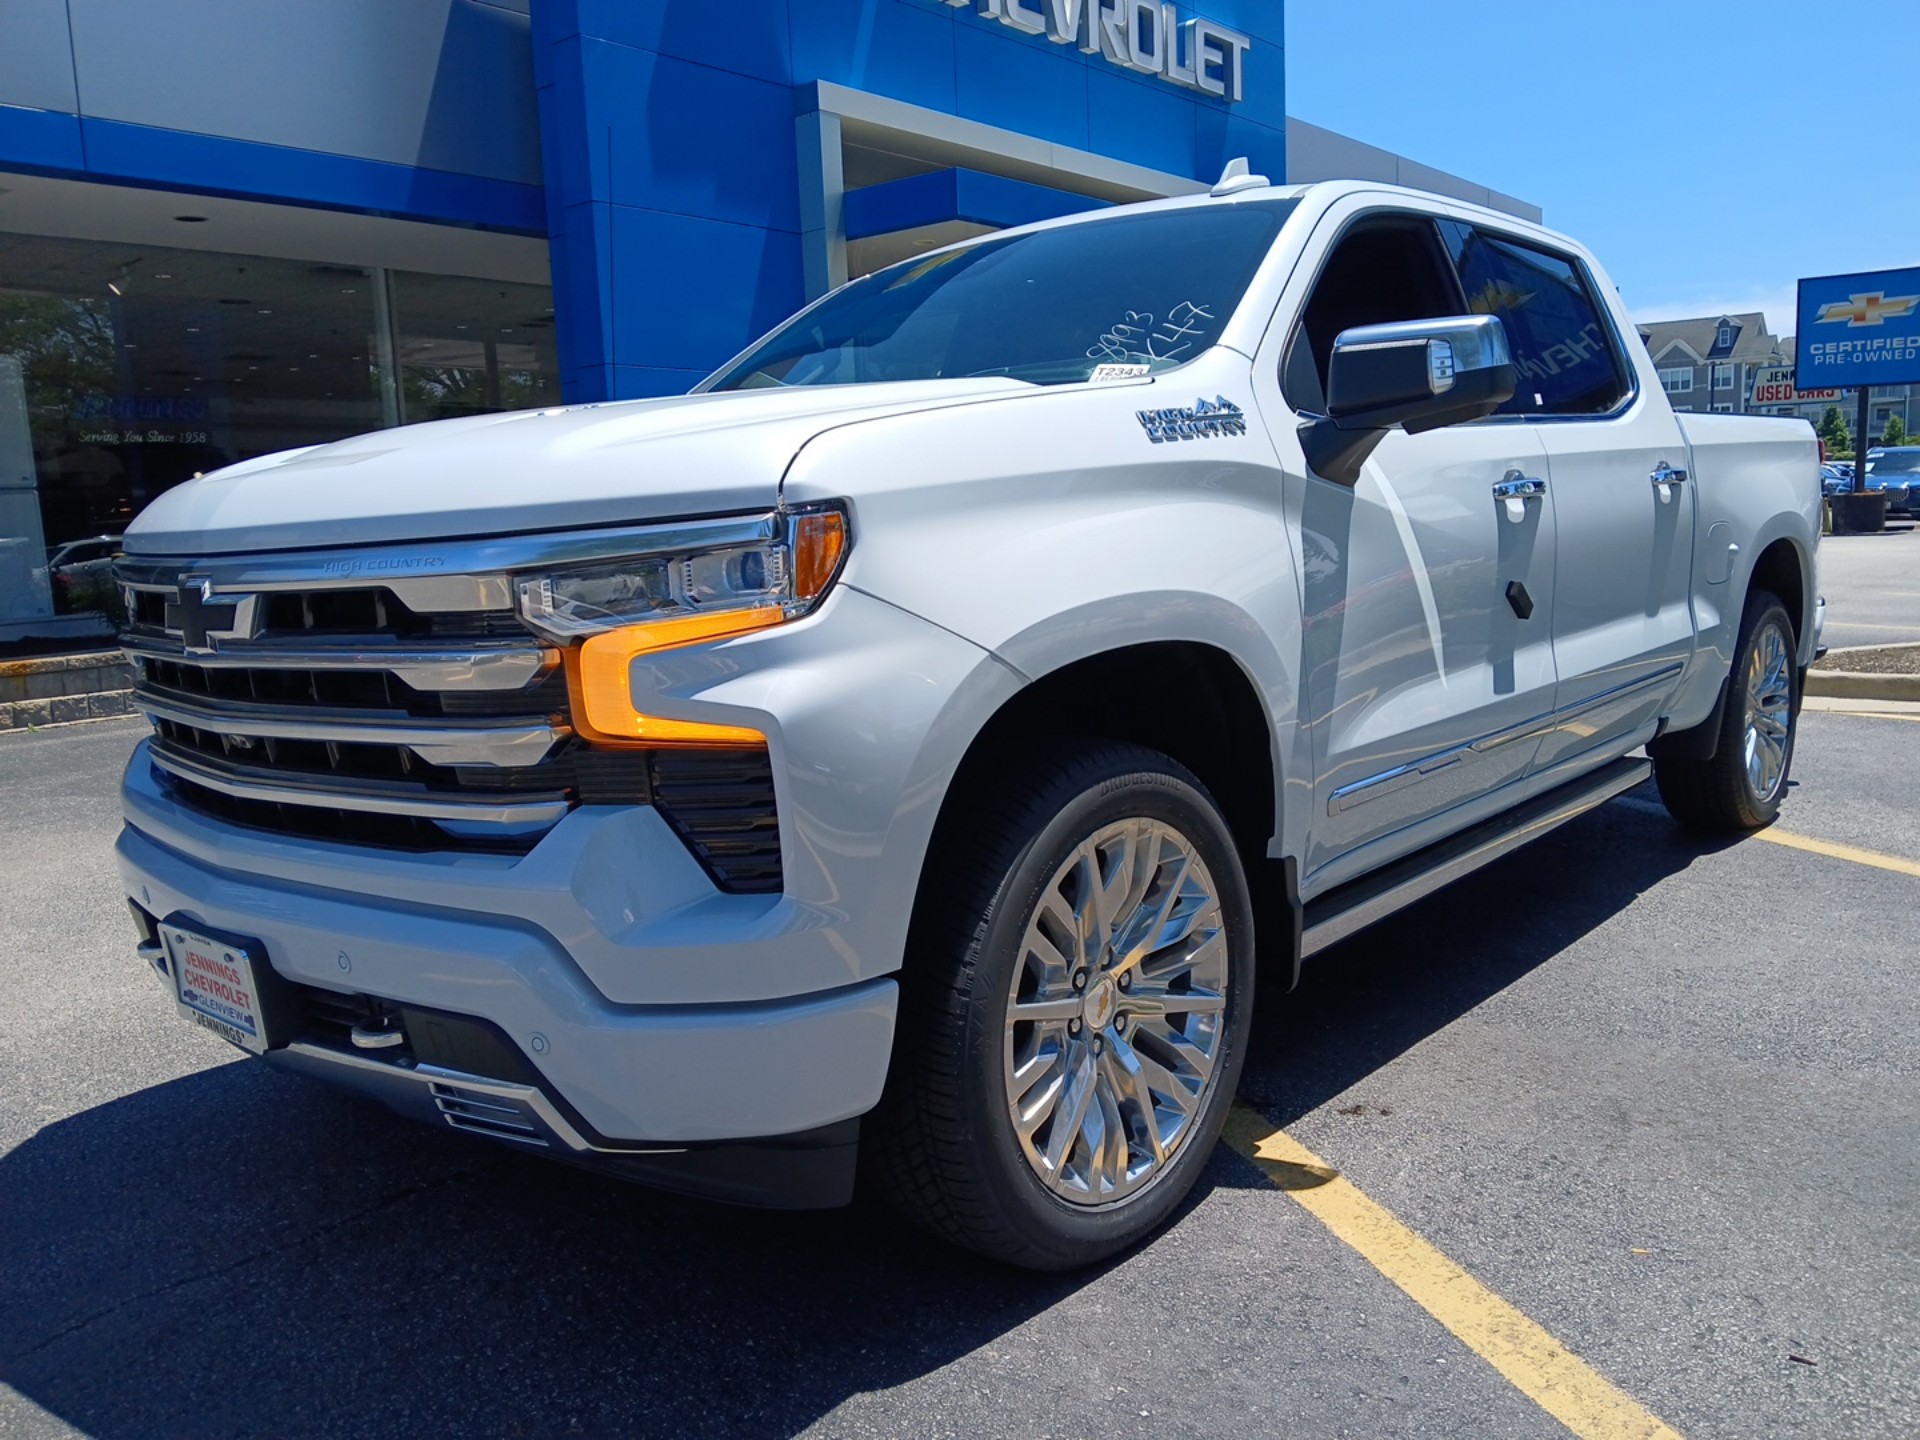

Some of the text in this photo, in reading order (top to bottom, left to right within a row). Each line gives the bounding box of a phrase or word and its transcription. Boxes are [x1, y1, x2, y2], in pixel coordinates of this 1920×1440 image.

[1085, 310, 1154, 362] 8993
[1809, 336, 1920, 355] CERTIFIED
[1815, 349, 1916, 365] PRE-OWNED
[1756, 384, 1793, 402] USED
[78, 431, 207, 444] Serving You Since 1958
[323, 556, 449, 574] HIGH COUNTRY
[184, 950, 241, 986] JENNINGS
[184, 969, 251, 1010] CHEVROLET
[199, 994, 244, 1023] GLENVIEW
